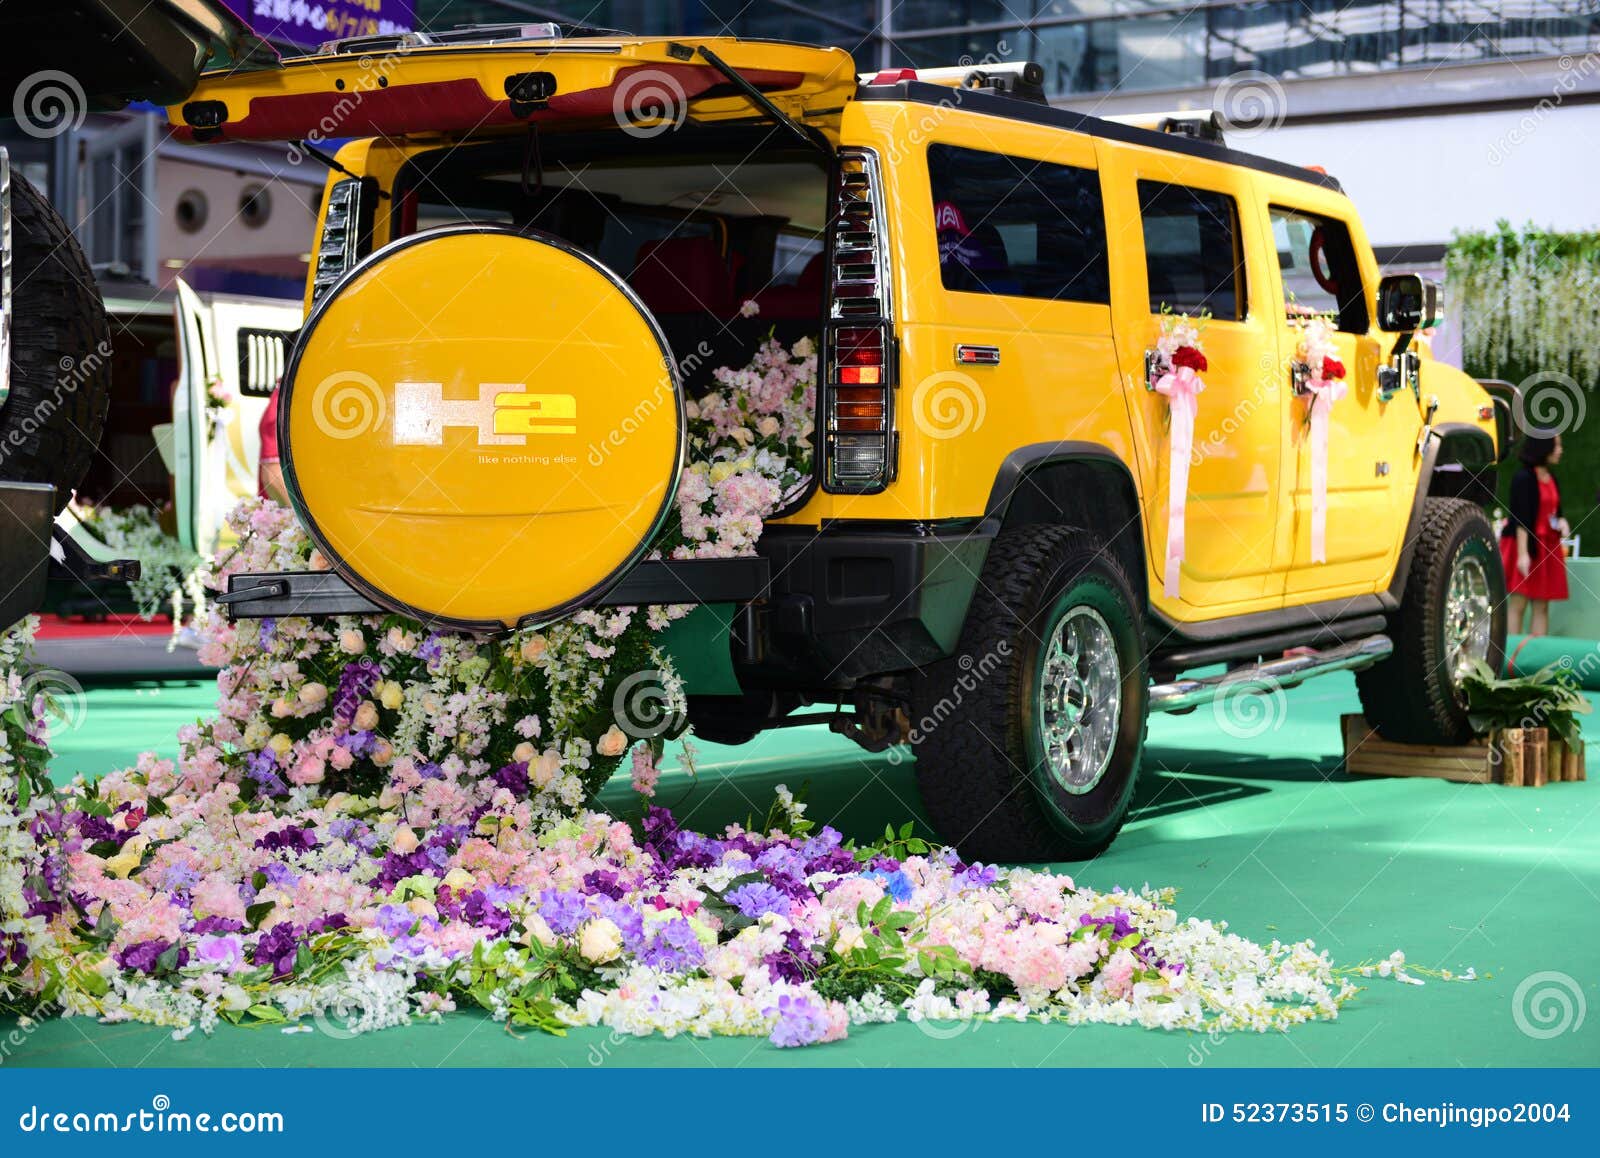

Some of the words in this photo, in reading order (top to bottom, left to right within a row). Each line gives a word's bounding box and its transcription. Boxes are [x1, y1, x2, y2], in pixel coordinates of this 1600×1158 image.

[393, 382, 577, 446] H2
[478, 455, 499, 465] like
[503, 455, 550, 467] nothing
[554, 455, 577, 465] else
